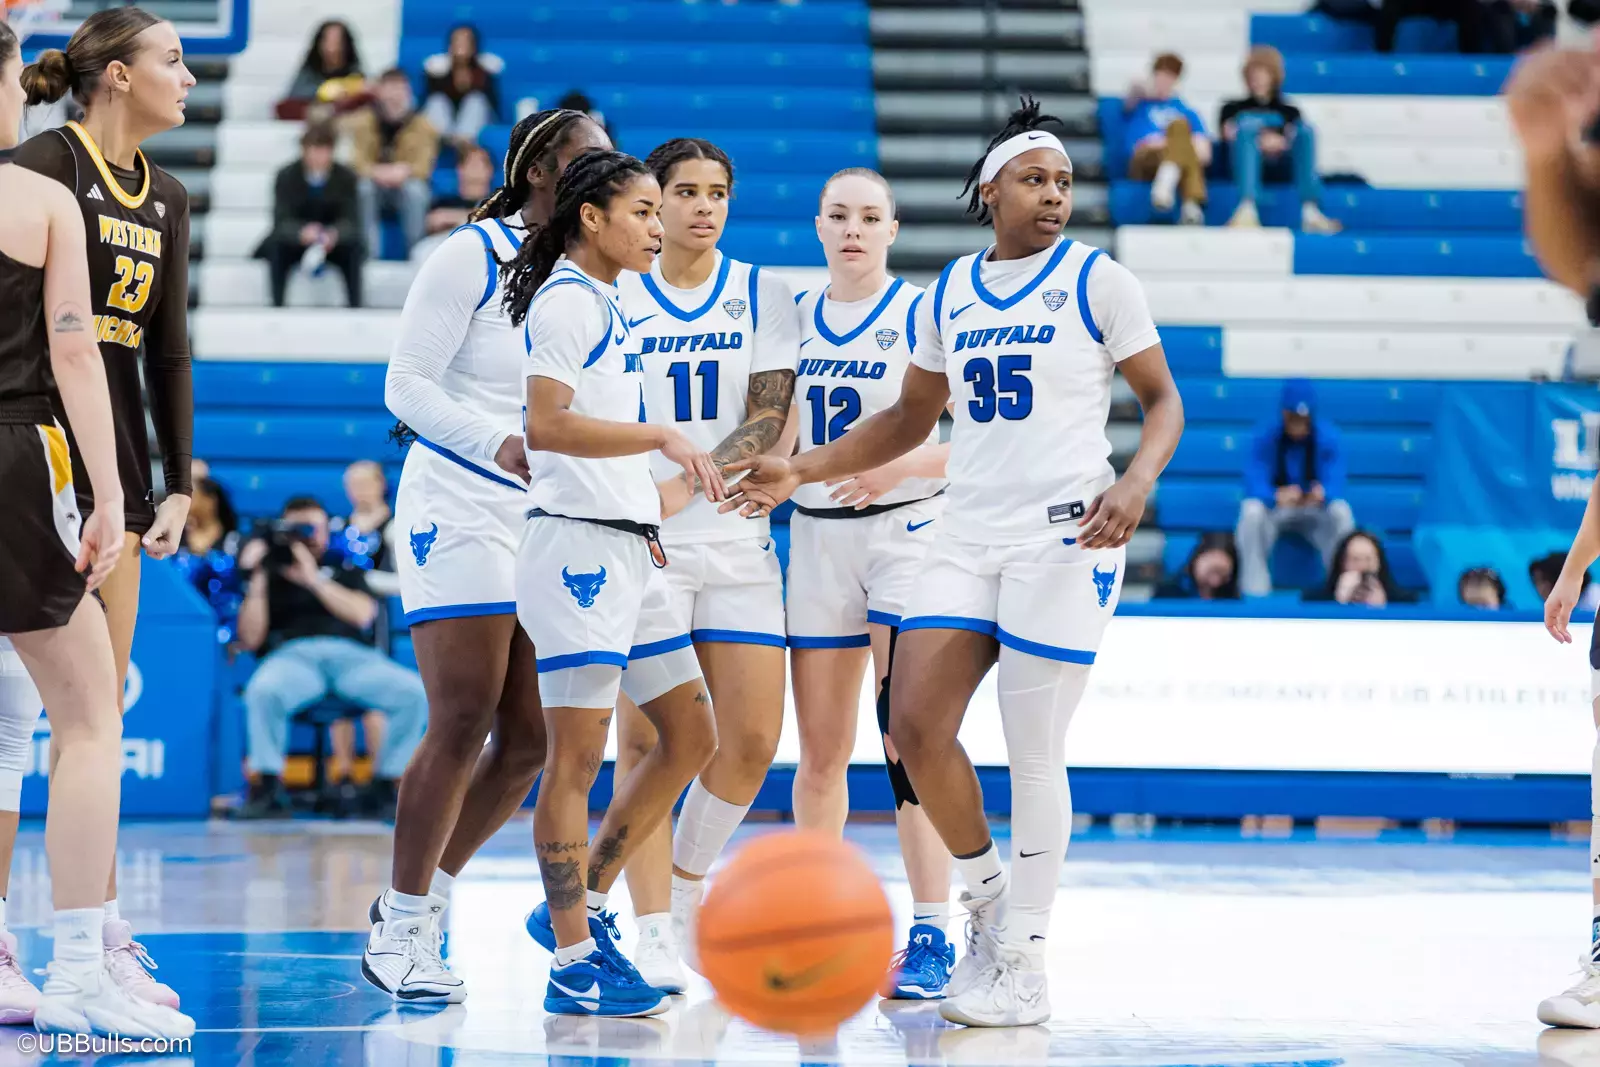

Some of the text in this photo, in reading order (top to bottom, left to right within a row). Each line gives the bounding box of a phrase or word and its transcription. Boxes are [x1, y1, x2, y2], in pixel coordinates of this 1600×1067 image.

[98, 215, 162, 258] WESTERN
[106, 254, 155, 313] 23
[641, 331, 743, 355] BUFFALO
[952, 324, 1056, 353] BUFFALO
[665, 360, 720, 423] 11
[805, 385, 862, 446] 12
[962, 354, 1034, 424] 35
